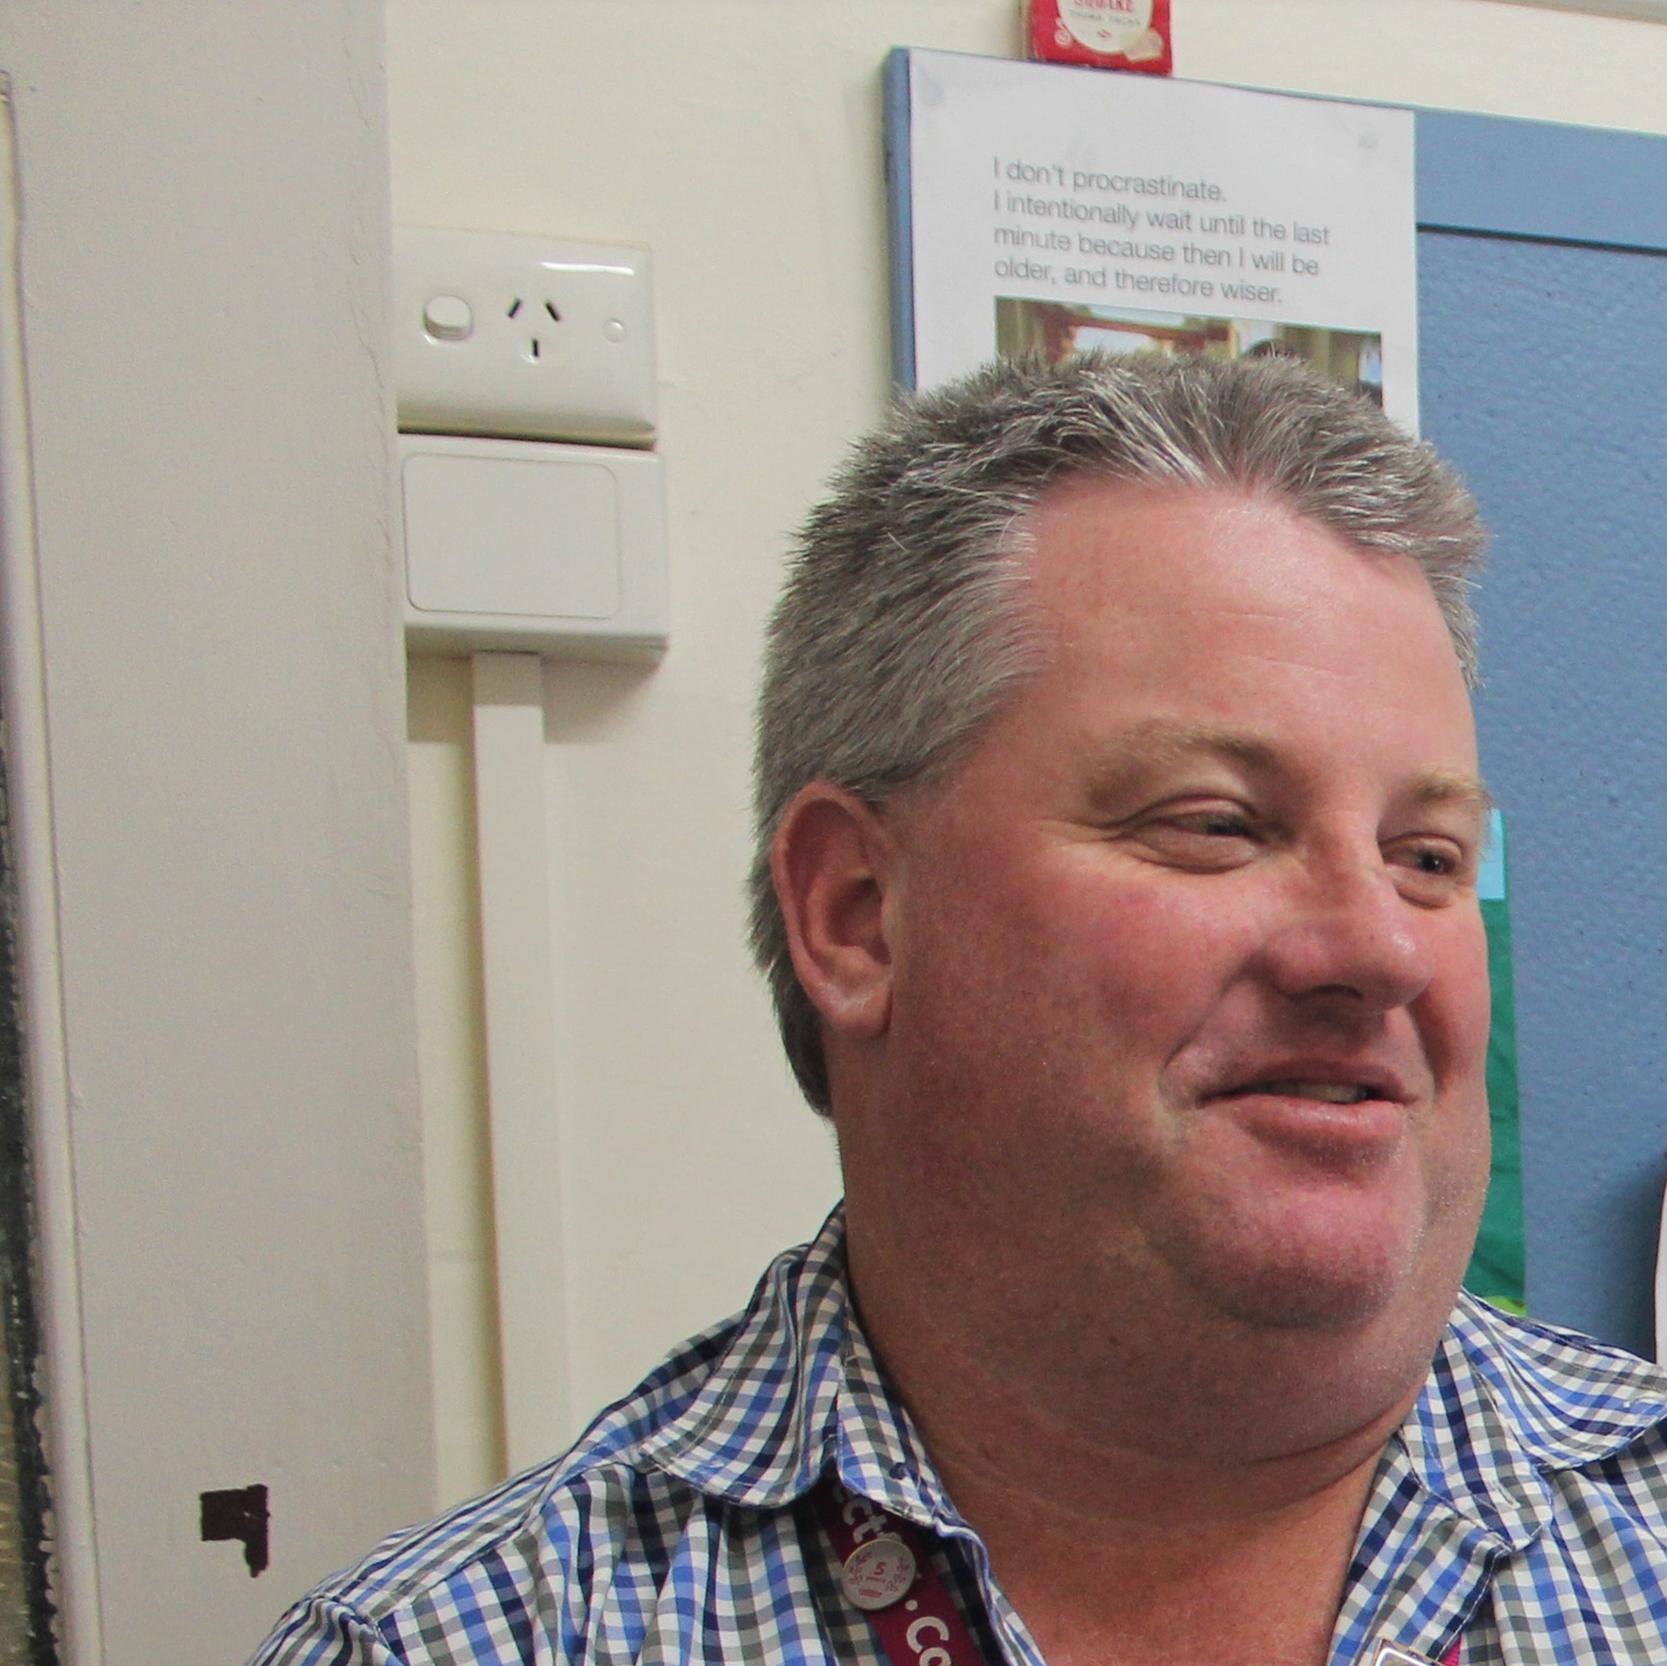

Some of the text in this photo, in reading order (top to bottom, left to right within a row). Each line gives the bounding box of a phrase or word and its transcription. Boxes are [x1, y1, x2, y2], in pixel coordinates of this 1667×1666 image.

[993, 158, 1227, 202] I don't procrastinate.
[993, 191, 1330, 245] I intentionally wait until the last
[994, 226, 1319, 276] minute because then I will be
[994, 257, 1282, 304] older, and therefore wiser.
